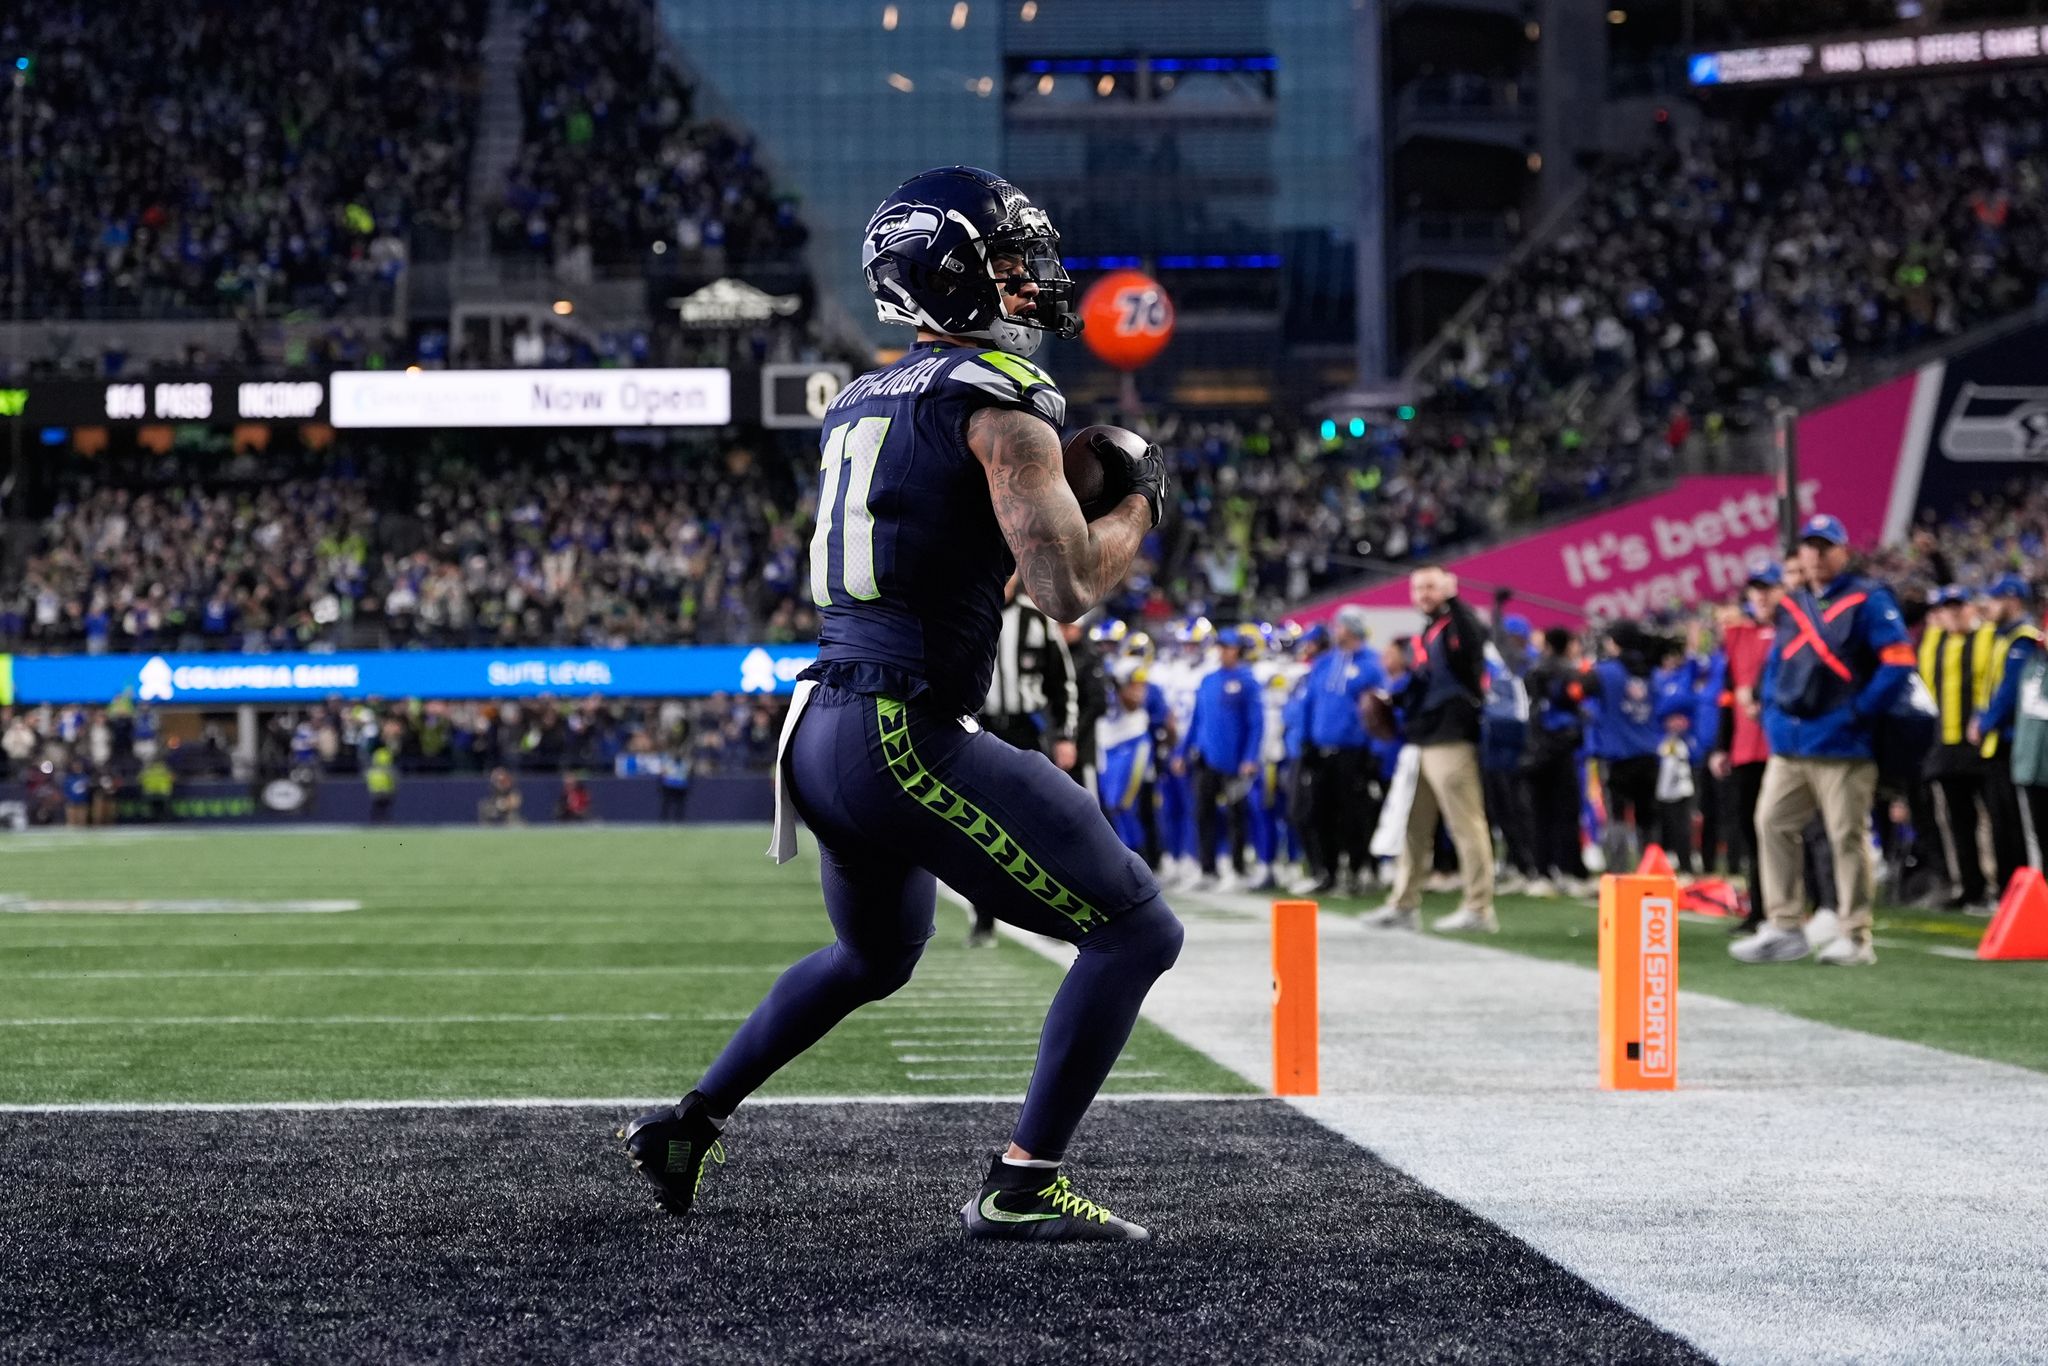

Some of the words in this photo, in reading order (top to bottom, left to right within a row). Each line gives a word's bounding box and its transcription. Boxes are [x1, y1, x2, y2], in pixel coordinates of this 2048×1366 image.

[1917, 31, 1982, 65] OFFICE
[1113, 285, 1174, 337] 76
[154, 383, 212, 419] PASS
[531, 382, 602, 410] Now
[620, 382, 707, 425] Open
[810, 416, 891, 607] 11
[1561, 531, 1650, 588] It's
[1651, 478, 1821, 560] bettr
[1584, 565, 1700, 626] over
[487, 660, 548, 686] SUITE
[549, 659, 612, 686] LEVEL
[1647, 905, 1667, 948] FOX
[1646, 957, 1667, 1069] SPORTS
